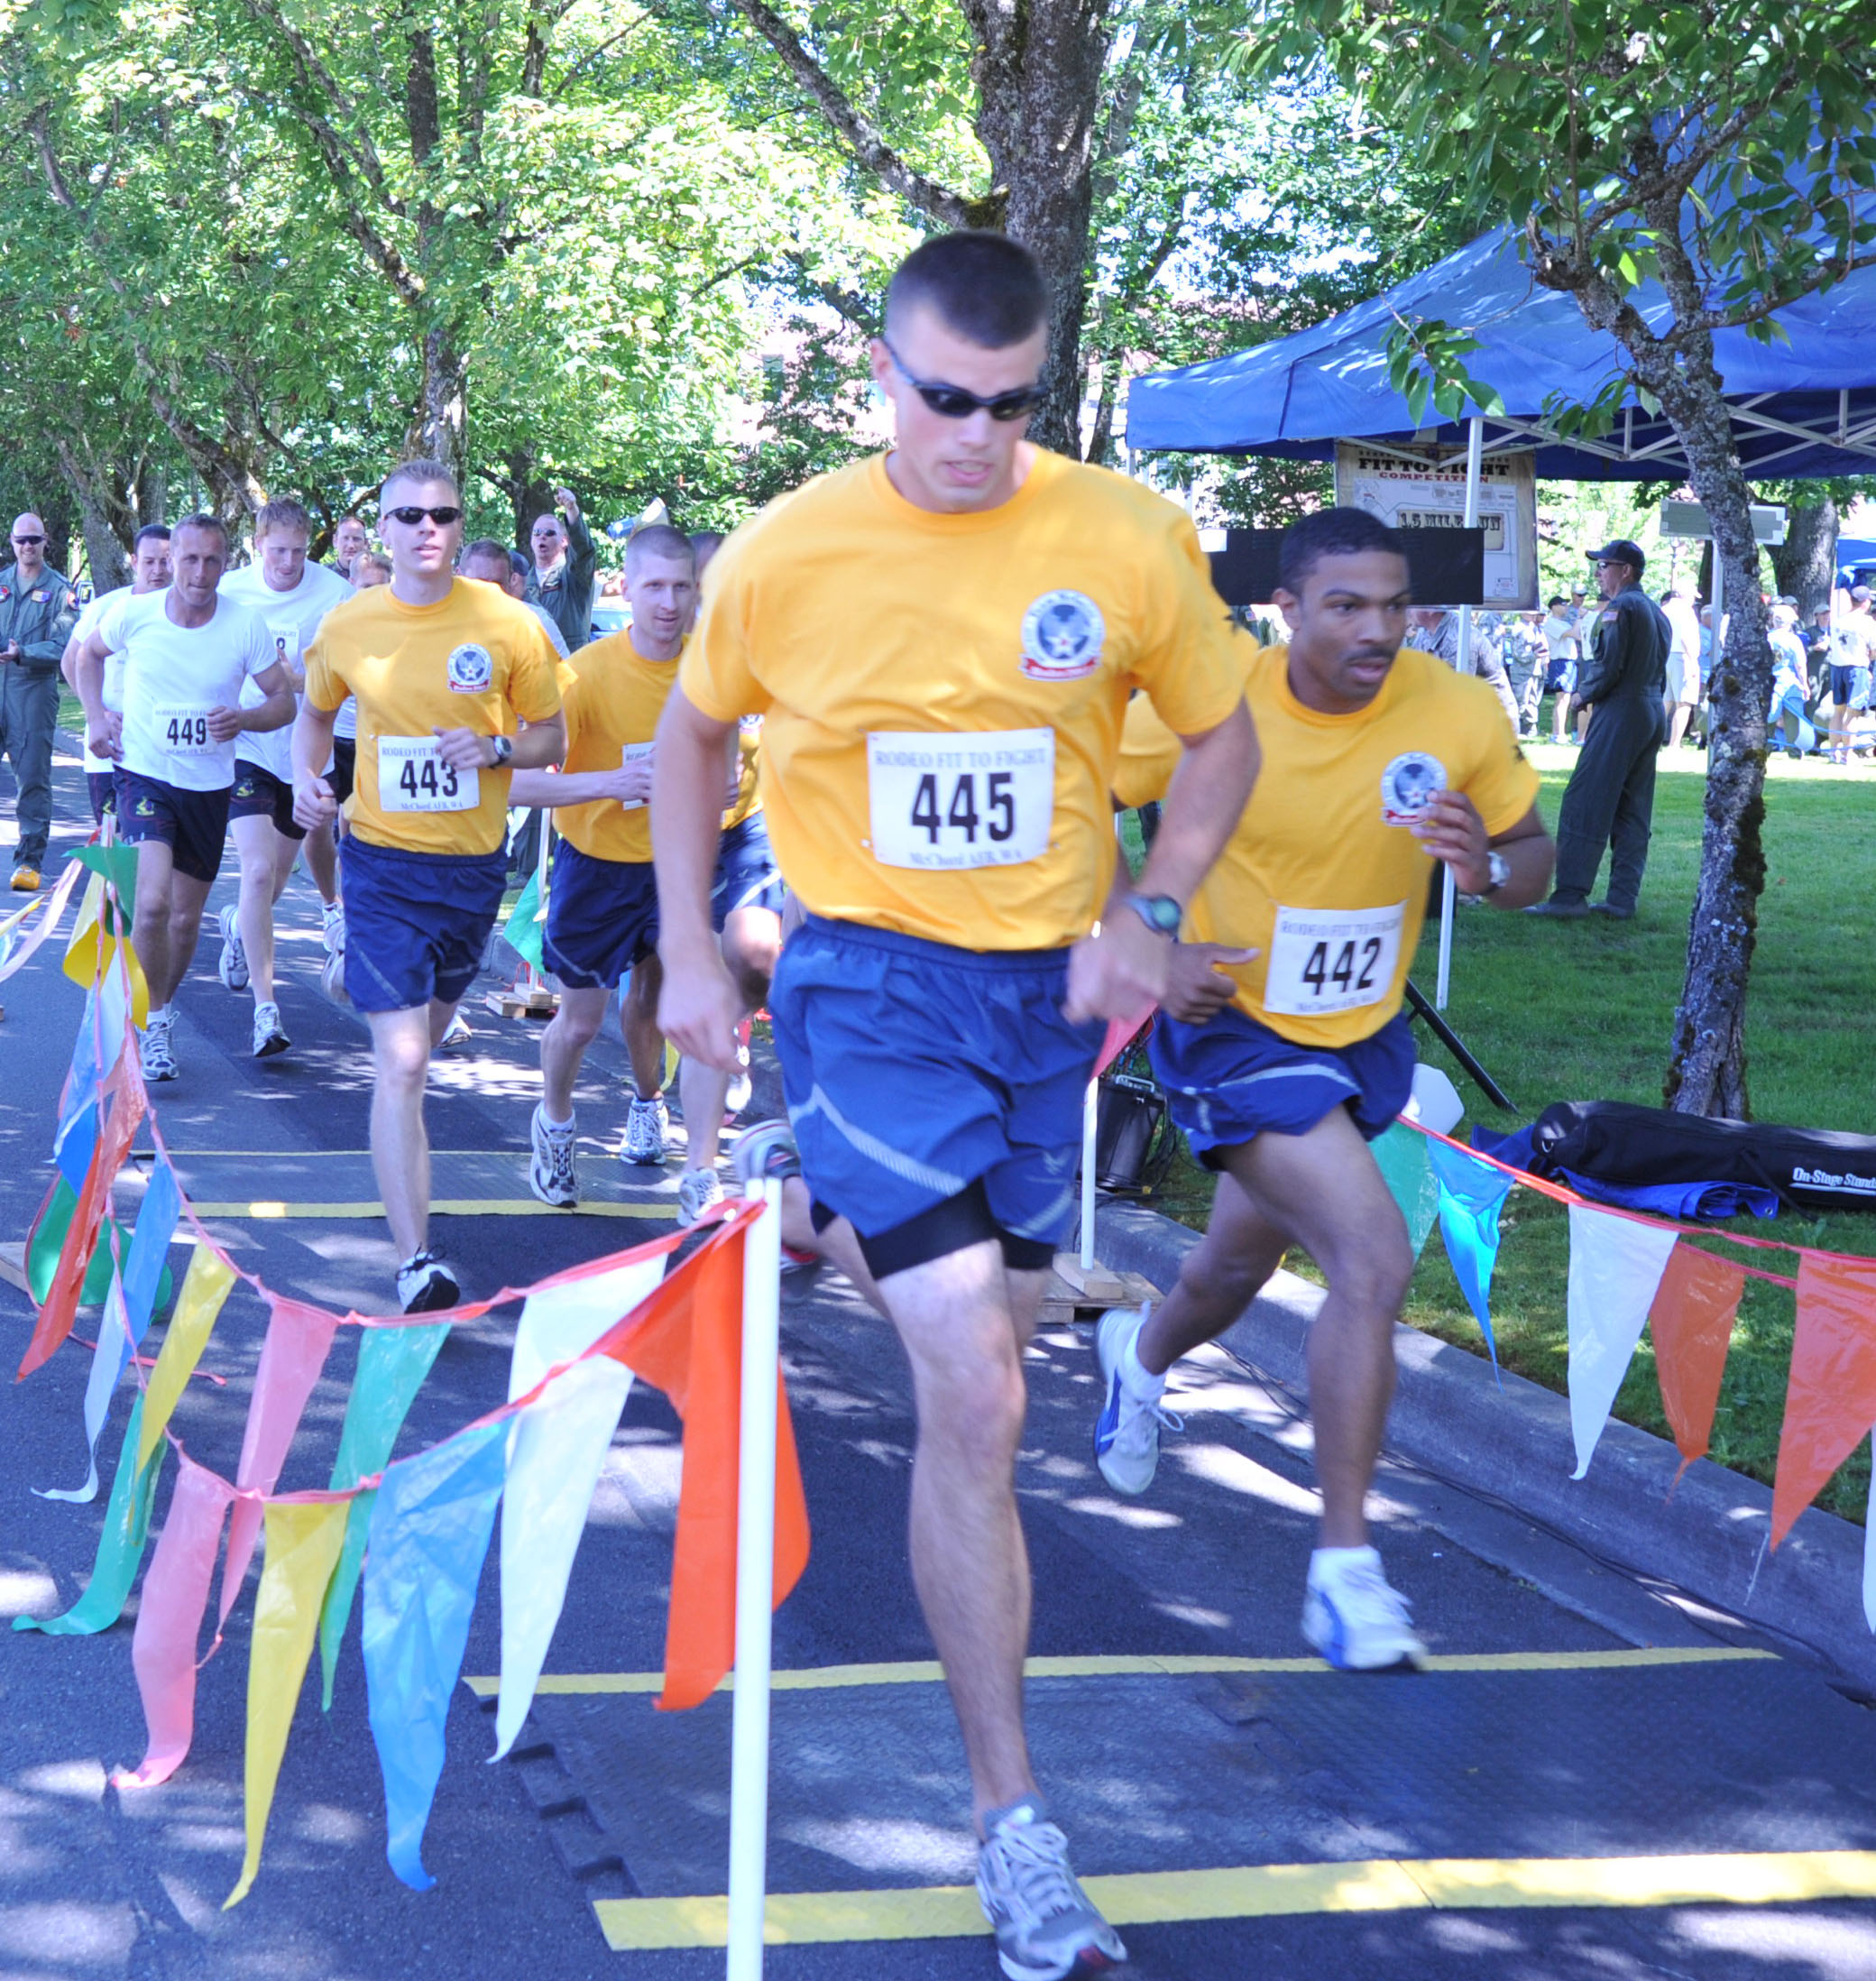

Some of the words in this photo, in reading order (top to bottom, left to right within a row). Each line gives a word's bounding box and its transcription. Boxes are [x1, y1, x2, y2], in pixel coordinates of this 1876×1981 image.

[1358, 458, 1395, 471] FIT
[1399, 460, 1430, 473] TO
[1379, 472, 1489, 484] COMPETITIN
[1476, 515, 1502, 530] UN
[167, 718, 207, 746] 449
[382, 747, 411, 757] RODEO
[875, 751, 933, 768] RODEO
[937, 751, 962, 768] FIT
[968, 751, 992, 768] TO
[996, 748, 1046, 766] FIGHT
[400, 760, 458, 798] 443
[912, 771, 1016, 844] 445
[1304, 938, 1381, 996] 442
[1792, 1166, 1844, 1186] On-Stage
